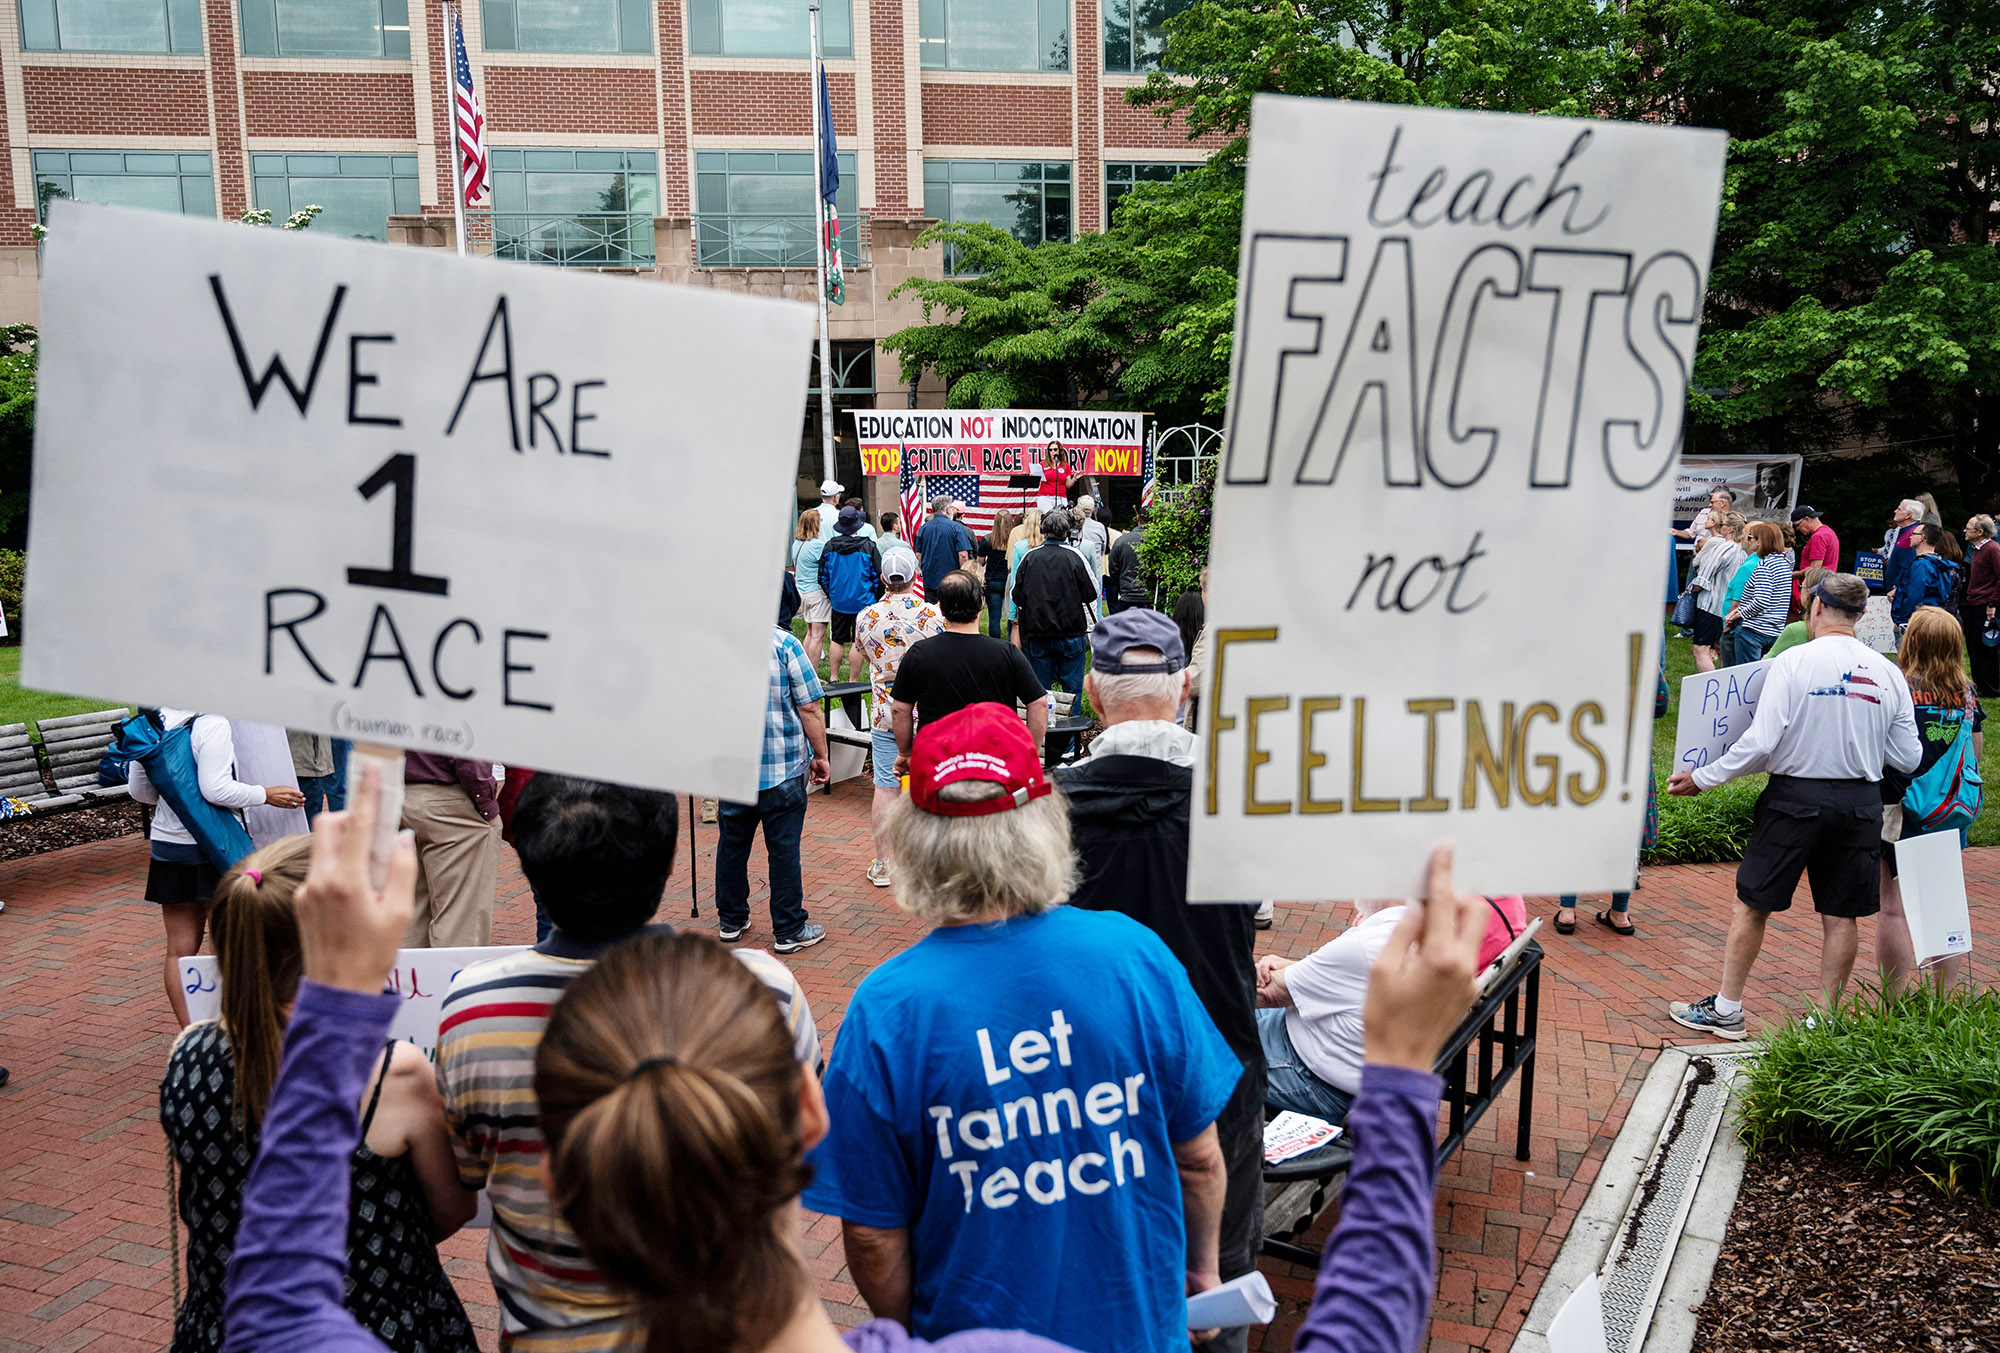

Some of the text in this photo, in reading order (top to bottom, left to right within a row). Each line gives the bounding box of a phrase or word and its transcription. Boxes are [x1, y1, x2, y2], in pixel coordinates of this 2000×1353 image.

[1367, 124, 1612, 234] teach
[209, 274, 612, 459] WE ARE
[1224, 232, 1702, 490] FACTS
[859, 416, 1135, 440] EDUCATION NOT INDOCTRINATION
[861, 448, 1138, 473] STOP CRITICAL RACE THRY NOW!
[1711, 476, 1727, 484] day
[346, 452, 450, 597] 1
[1344, 529, 1490, 614] not
[261, 587, 556, 712] RACE
[1702, 668, 1762, 715] RAC
[421, 719, 475, 752] race)
[1205, 627, 1644, 815] FEELINGS!
[1712, 716, 1728, 738] IS
[976, 1009, 1073, 1086] Let
[928, 1072, 1145, 1159] Tanner
[949, 1131, 1145, 1214] Teach
